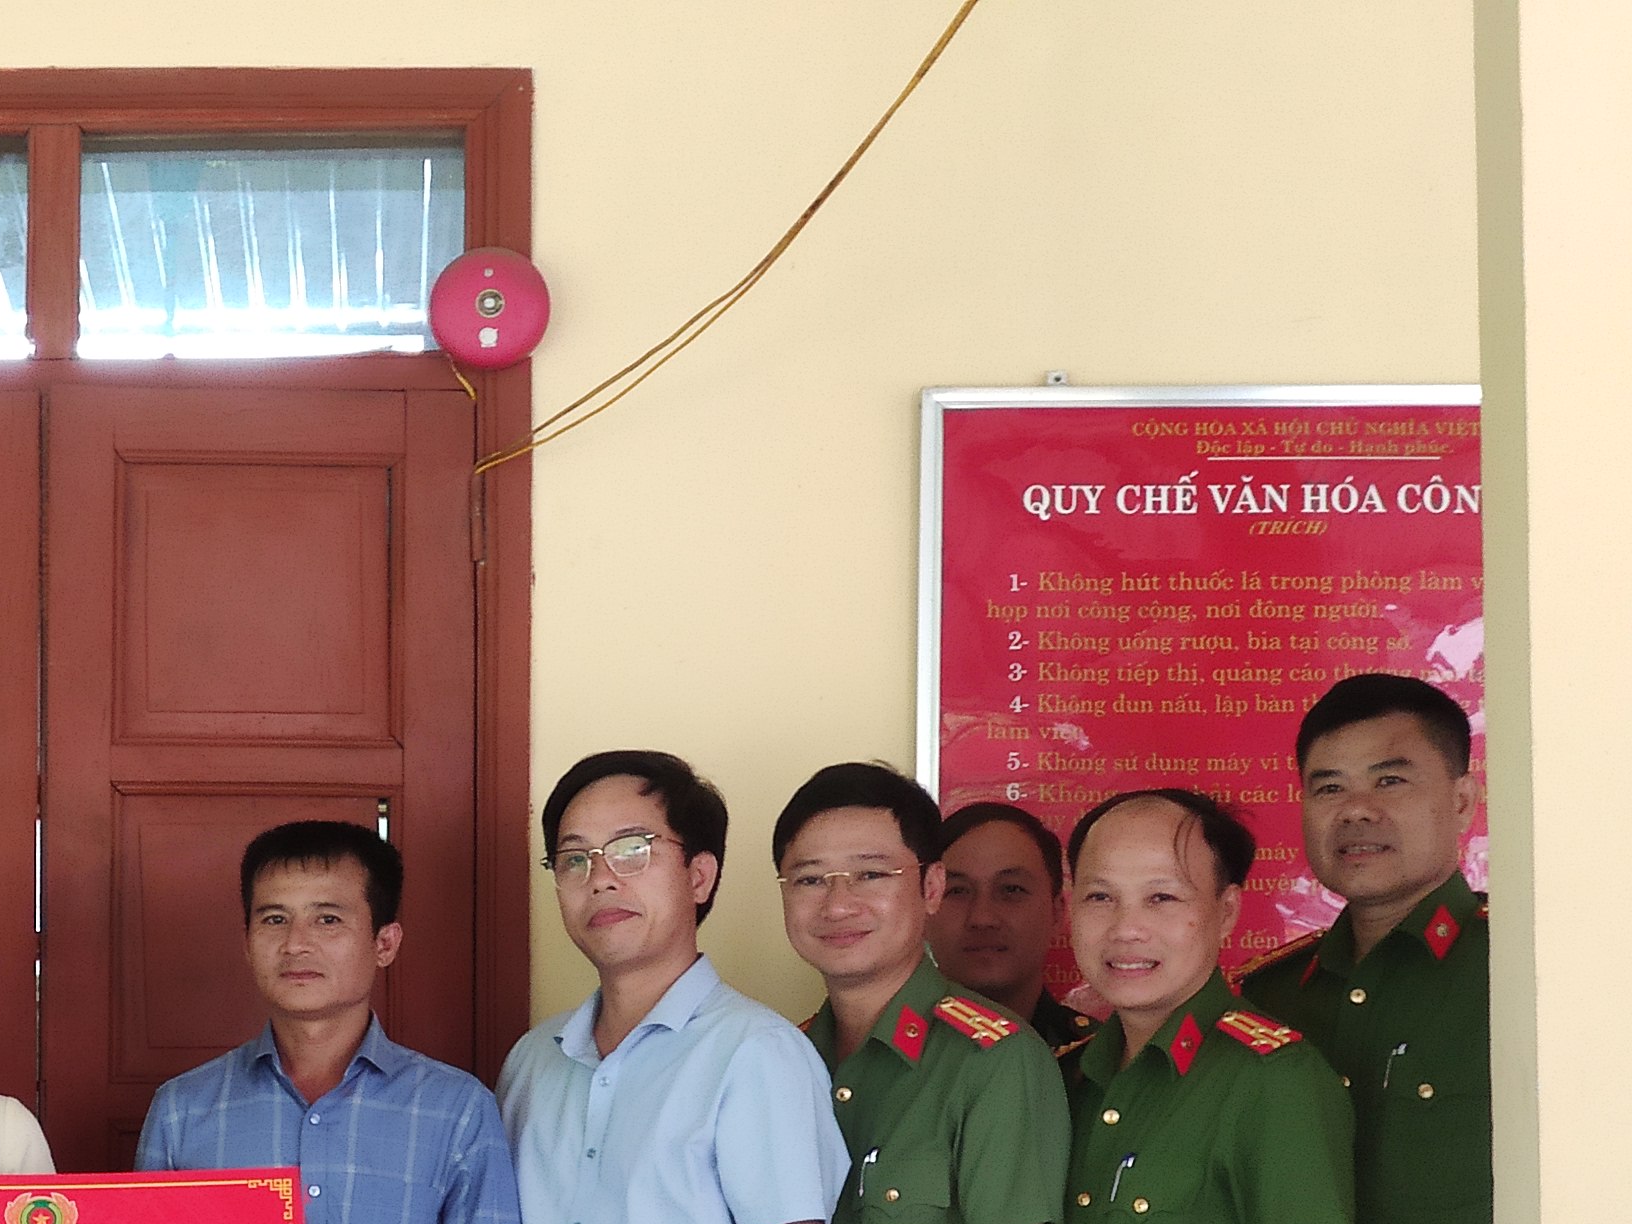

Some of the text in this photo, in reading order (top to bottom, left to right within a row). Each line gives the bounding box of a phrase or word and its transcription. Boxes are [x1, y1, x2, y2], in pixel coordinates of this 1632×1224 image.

[1132, 417, 1188, 440] CỘNG
[1242, 416, 1268, 436] XÃ
[1317, 416, 1358, 436] CHỦ
[1022, 484, 1106, 520] QUY
[1116, 470, 1199, 514] CHẾ
[1207, 475, 1290, 514] VĂN
[1301, 475, 1386, 514] HÓA
[1249, 515, 1328, 536] (TRÍCH)
[1009, 574, 1028, 592] 1-
[1039, 571, 1114, 595] Không
[1121, 571, 1161, 591] hút
[1169, 569, 1234, 591] thuốc
[1241, 571, 1261, 590] lá
[1270, 575, 1334, 594] trong
[1340, 571, 1413, 594] phòng
[1420, 570, 1462, 590] làm
[1036, 600, 1070, 618] nơi
[1078, 601, 1131, 623] công
[1138, 600, 1197, 623] cộng,
[1206, 600, 1241, 618] nơi
[1249, 599, 1305, 621] đông
[1008, 631, 1029, 650] 2-
[1037, 632, 1111, 654] Không
[1119, 630, 1173, 654] uống
[1248, 631, 1281, 650] bia
[1290, 632, 1319, 654] tại
[1327, 632, 1378, 654] công
[1008, 663, 1028, 682] 3-
[1037, 662, 1111, 685] Không
[1118, 661, 1160, 686] tiếp
[1213, 661, 1283, 686] quảng
[1289, 663, 1327, 682] cáo
[1009, 695, 1030, 713] 4-
[1038, 693, 1106, 717] Không
[1215, 693, 1248, 717] lập
[1255, 693, 1295, 713] bàn
[987, 721, 1029, 740] làm
[1006, 752, 1029, 770] 5-
[1145, 752, 1200, 775] dụng
[1207, 752, 1252, 775] máy
[1260, 752, 1279, 770] vi
[1005, 782, 1028, 800] 6-
[1239, 785, 1279, 803] các
[1240, 929, 1280, 949] đến
